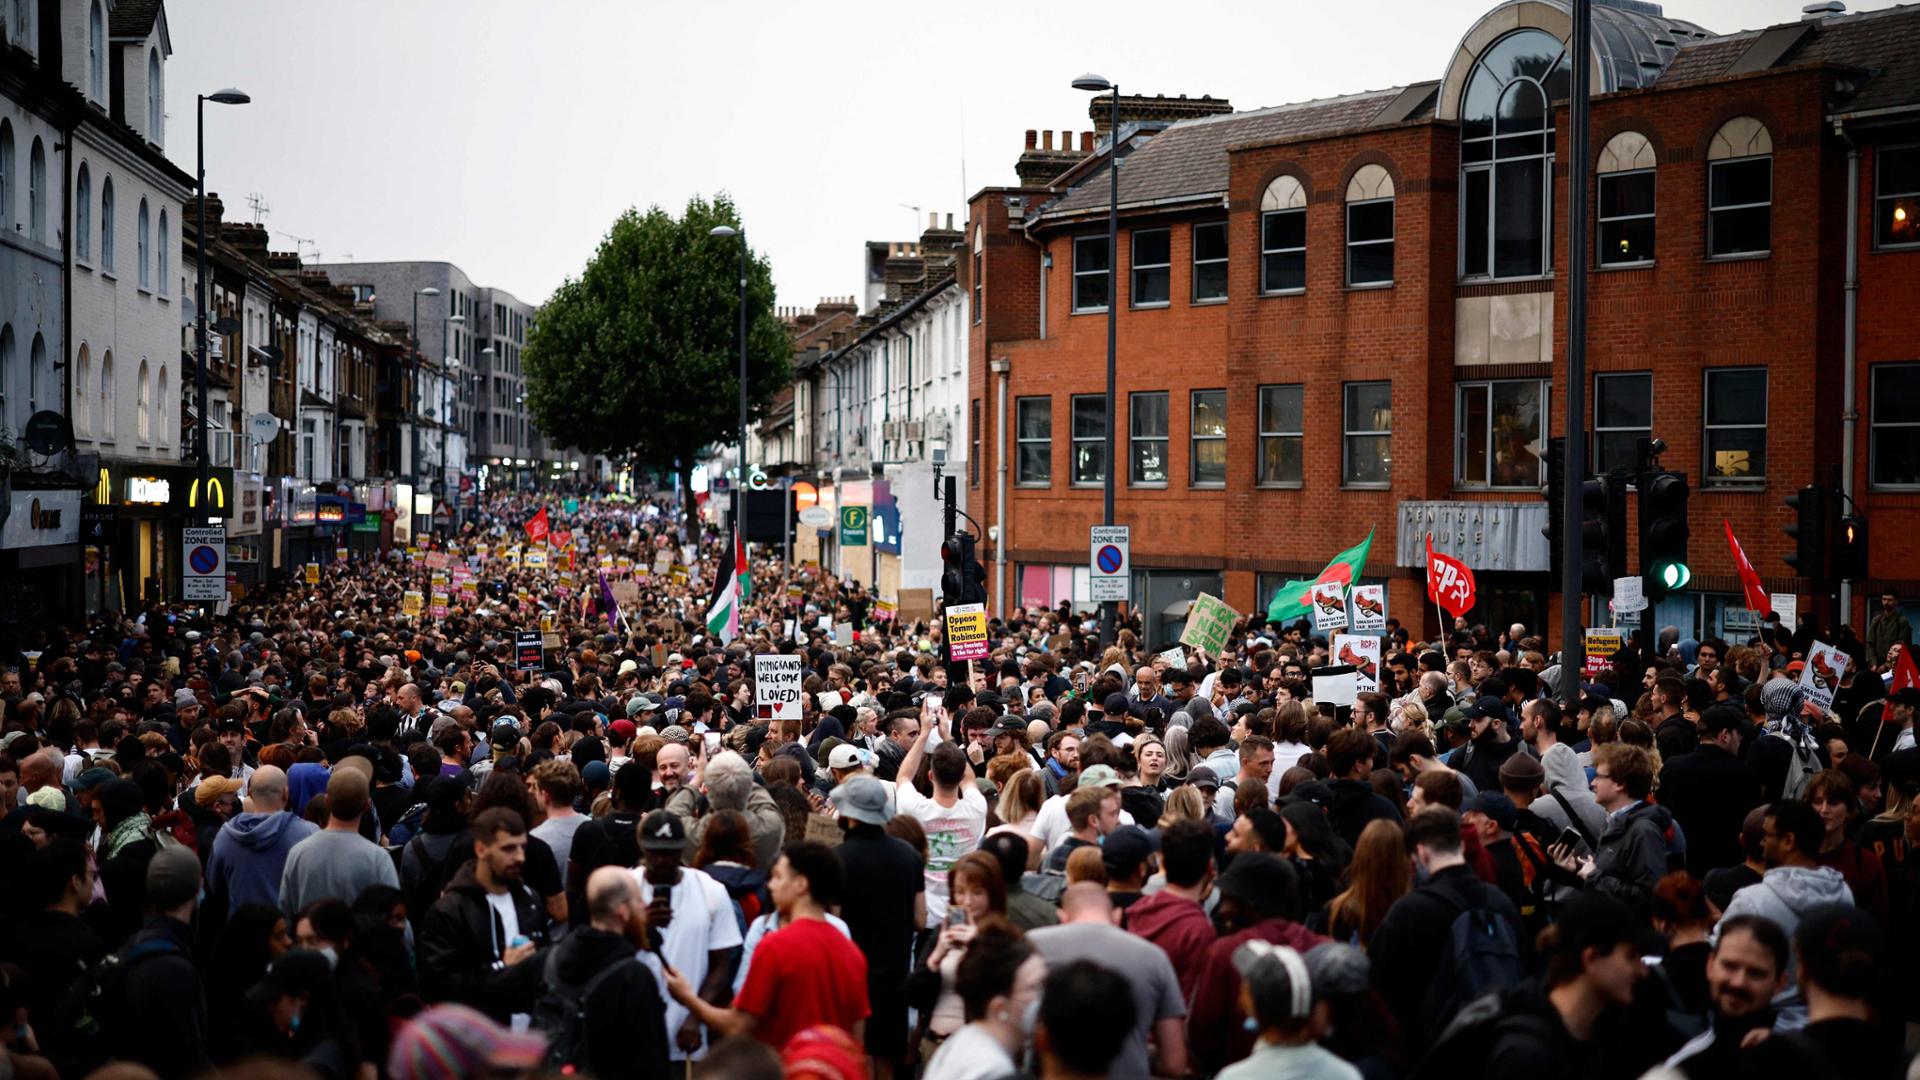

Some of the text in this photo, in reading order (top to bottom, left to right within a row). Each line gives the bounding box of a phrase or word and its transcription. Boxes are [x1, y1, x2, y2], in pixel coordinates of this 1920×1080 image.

[1407, 507, 1500, 524] CENTRAL
[1092, 536, 1114, 544] ZONE
[1414, 531, 1483, 544] HOUSE
[1195, 596, 1237, 630] FUCK
[949, 615, 977, 625] Oppose
[950, 625, 977, 633] Tommy
[1195, 616, 1227, 644] NAZI
[951, 632, 985, 642] Robinson
[1588, 637, 1618, 646] Refugees
[1186, 629, 1220, 657] SCUM
[1588, 656, 1604, 664] Stop
[757, 661, 801, 671] IMMIGRANTS
[758, 673, 799, 684] WELCOME
[760, 688, 800, 703] LOVED!
[1800, 686, 1821, 699] SMASH
